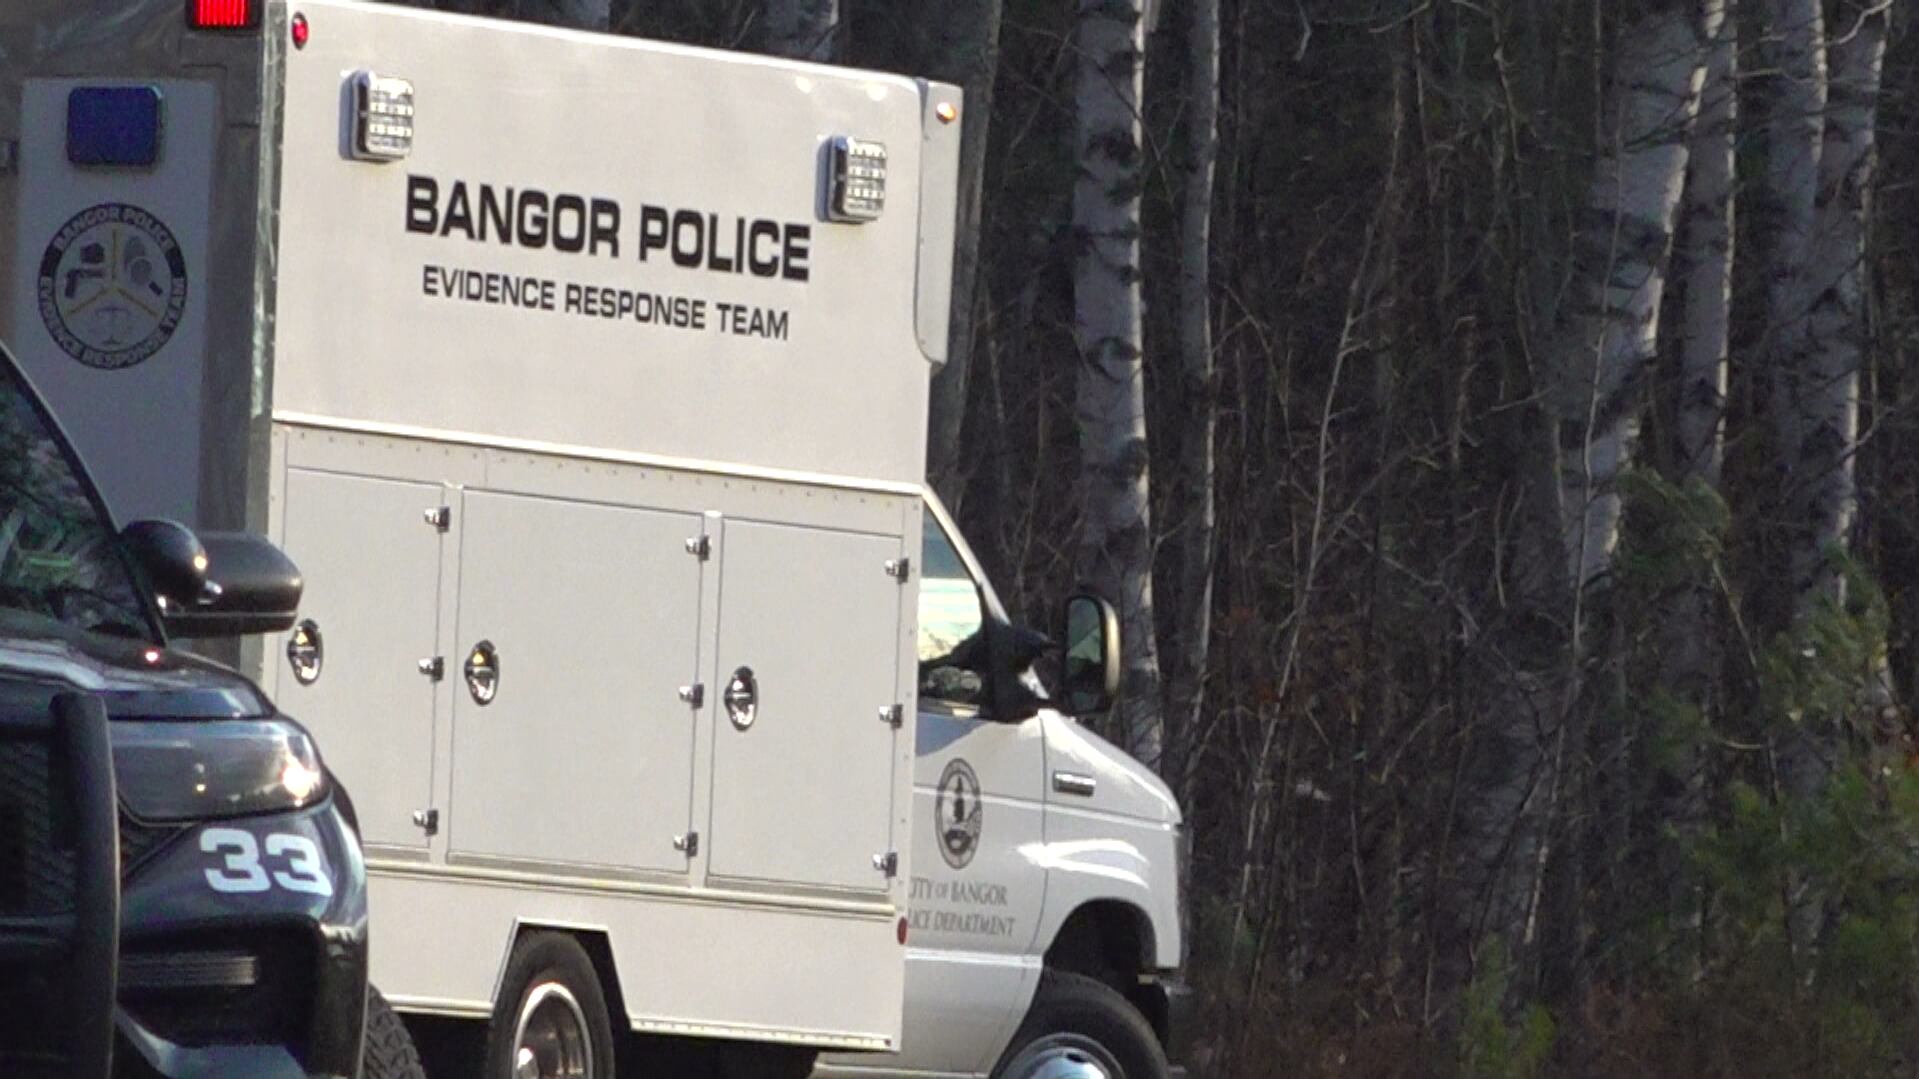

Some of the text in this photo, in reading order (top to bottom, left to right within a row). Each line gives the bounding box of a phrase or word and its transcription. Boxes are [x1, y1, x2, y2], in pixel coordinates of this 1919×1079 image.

[53, 205, 176, 252] BANGOR POLICE
[405, 173, 811, 282] BANGOR POLICE
[422, 264, 790, 340] EVIDENCE RESPONSE TEAM
[200, 828, 334, 897] 33
[950, 880, 1009, 906] BANGOR
[934, 909, 1017, 937] DEPARTMENT
